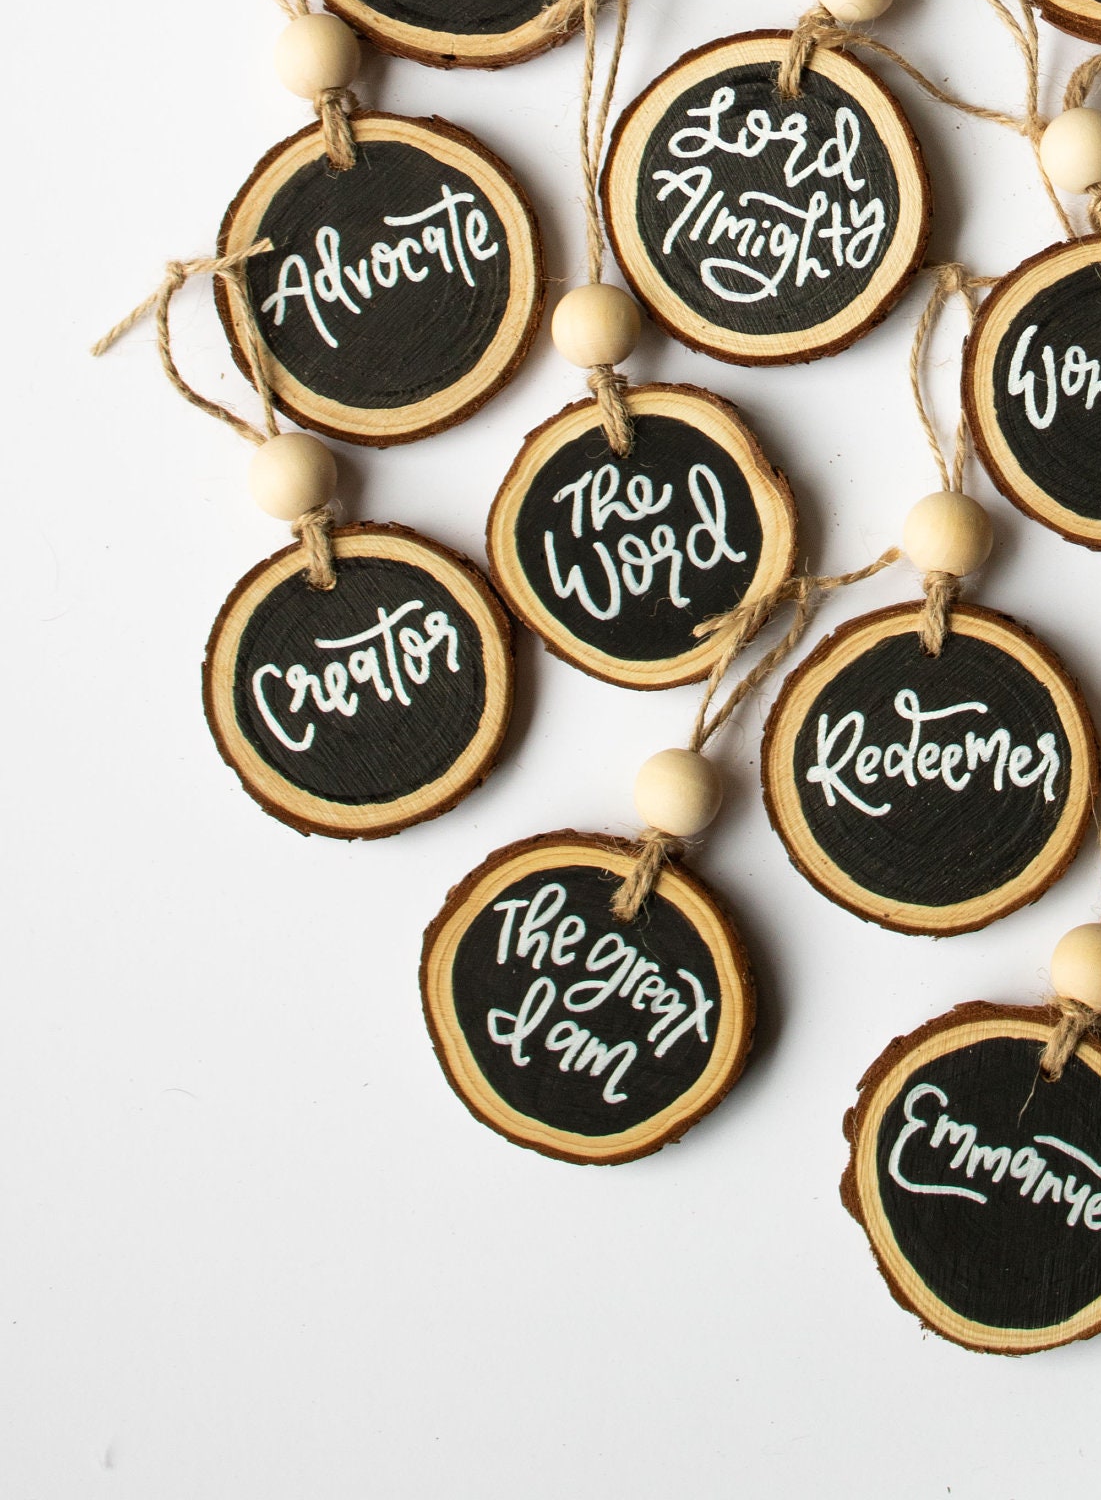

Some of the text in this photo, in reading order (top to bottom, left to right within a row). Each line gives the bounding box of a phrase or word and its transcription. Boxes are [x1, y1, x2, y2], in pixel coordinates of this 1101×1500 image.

[667, 85, 866, 192] Lord
[260, 183, 499, 349] Advocate
[651, 165, 887, 304] Almighty
[543, 463, 747, 621] Word
[552, 463, 673, 539] The
[251, 599, 461, 752] Creator
[805, 688, 1061, 817] Redeemer
[492, 882, 586, 970] The
[487, 976, 638, 1104] I am
